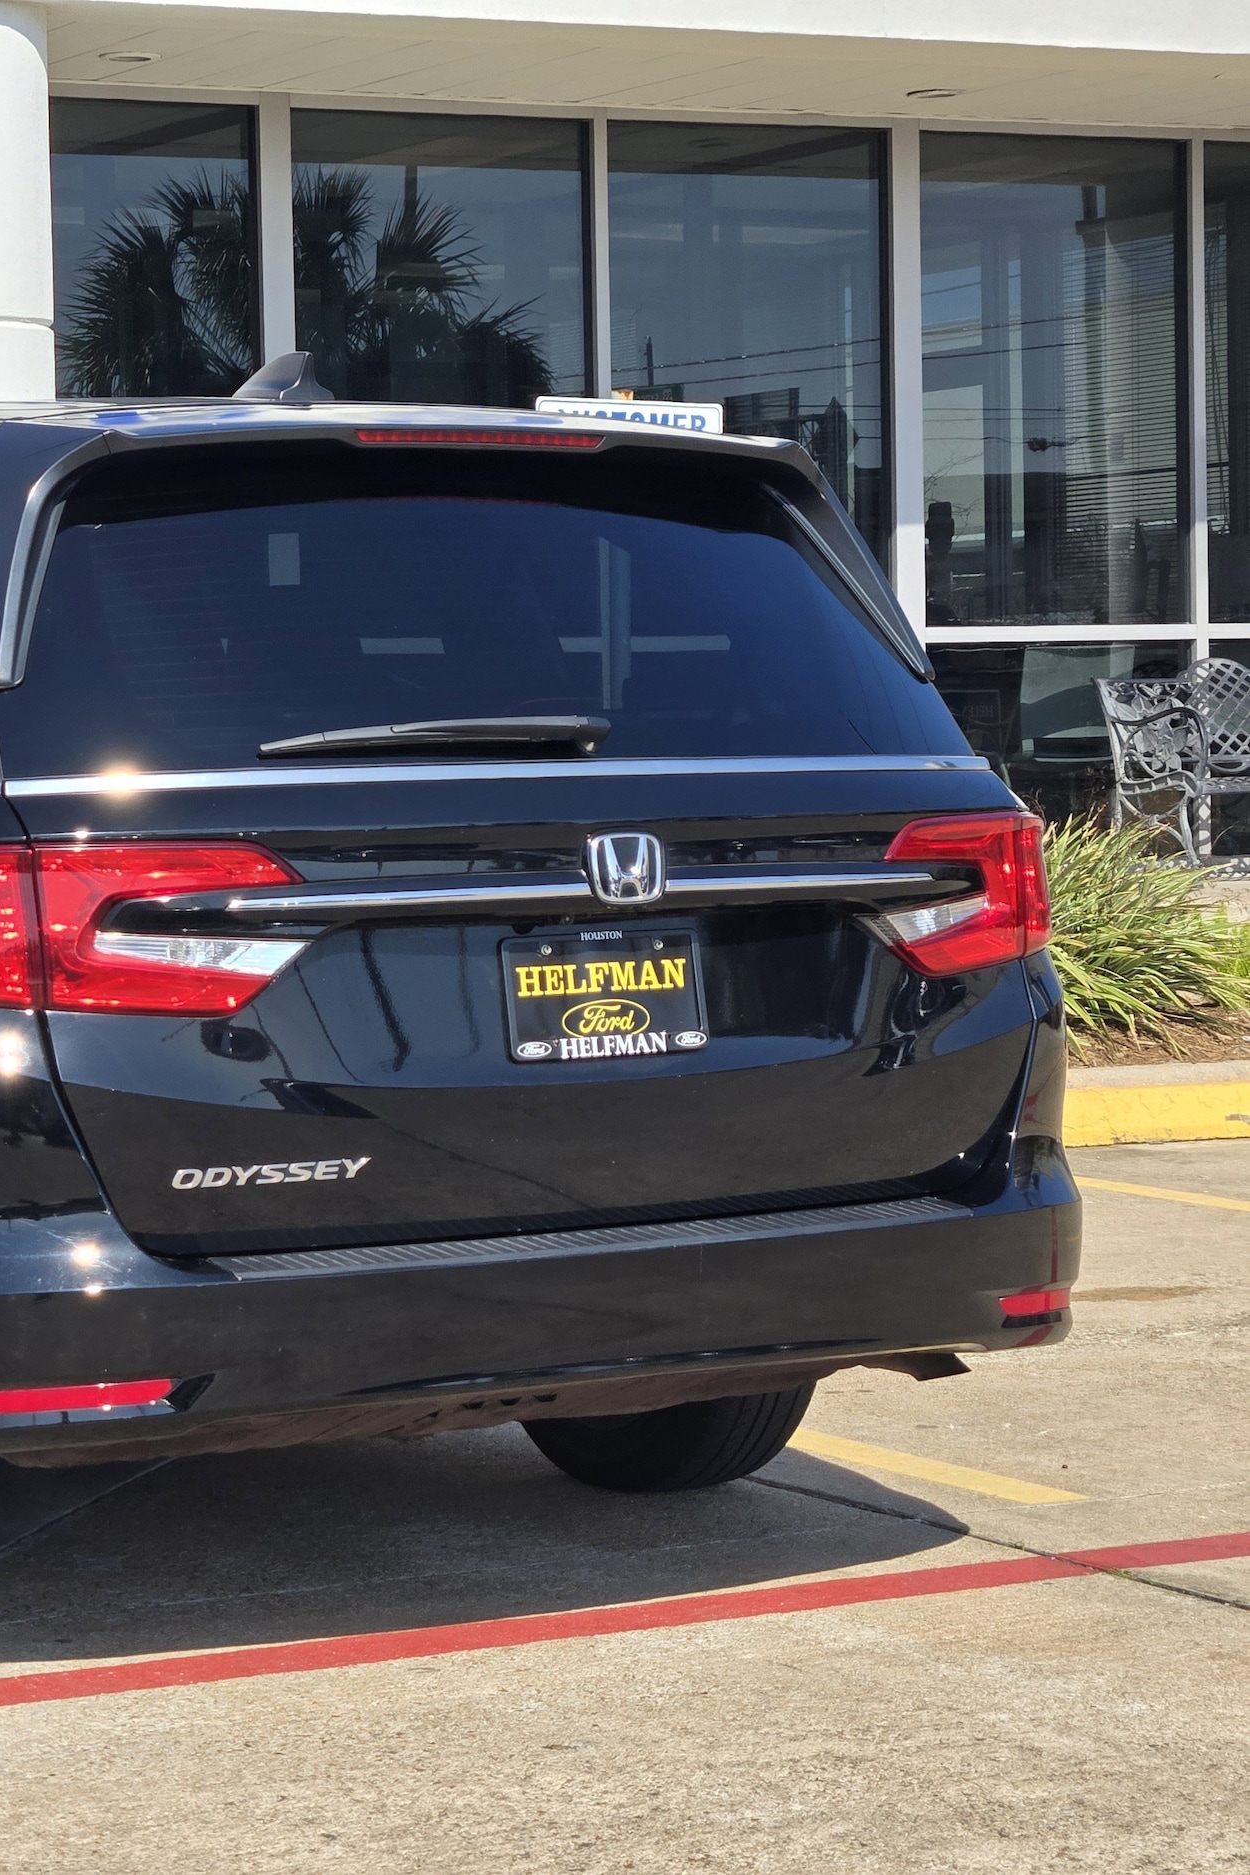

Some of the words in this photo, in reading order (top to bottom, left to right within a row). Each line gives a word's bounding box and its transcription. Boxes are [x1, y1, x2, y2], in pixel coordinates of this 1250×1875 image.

[580, 930, 623, 941] HOUSTON
[515, 957, 687, 998] HELFMAN
[578, 1004, 636, 1034] Ford
[559, 1031, 669, 1060] HELFMAN
[171, 1156, 372, 1190] ODYSSEY
